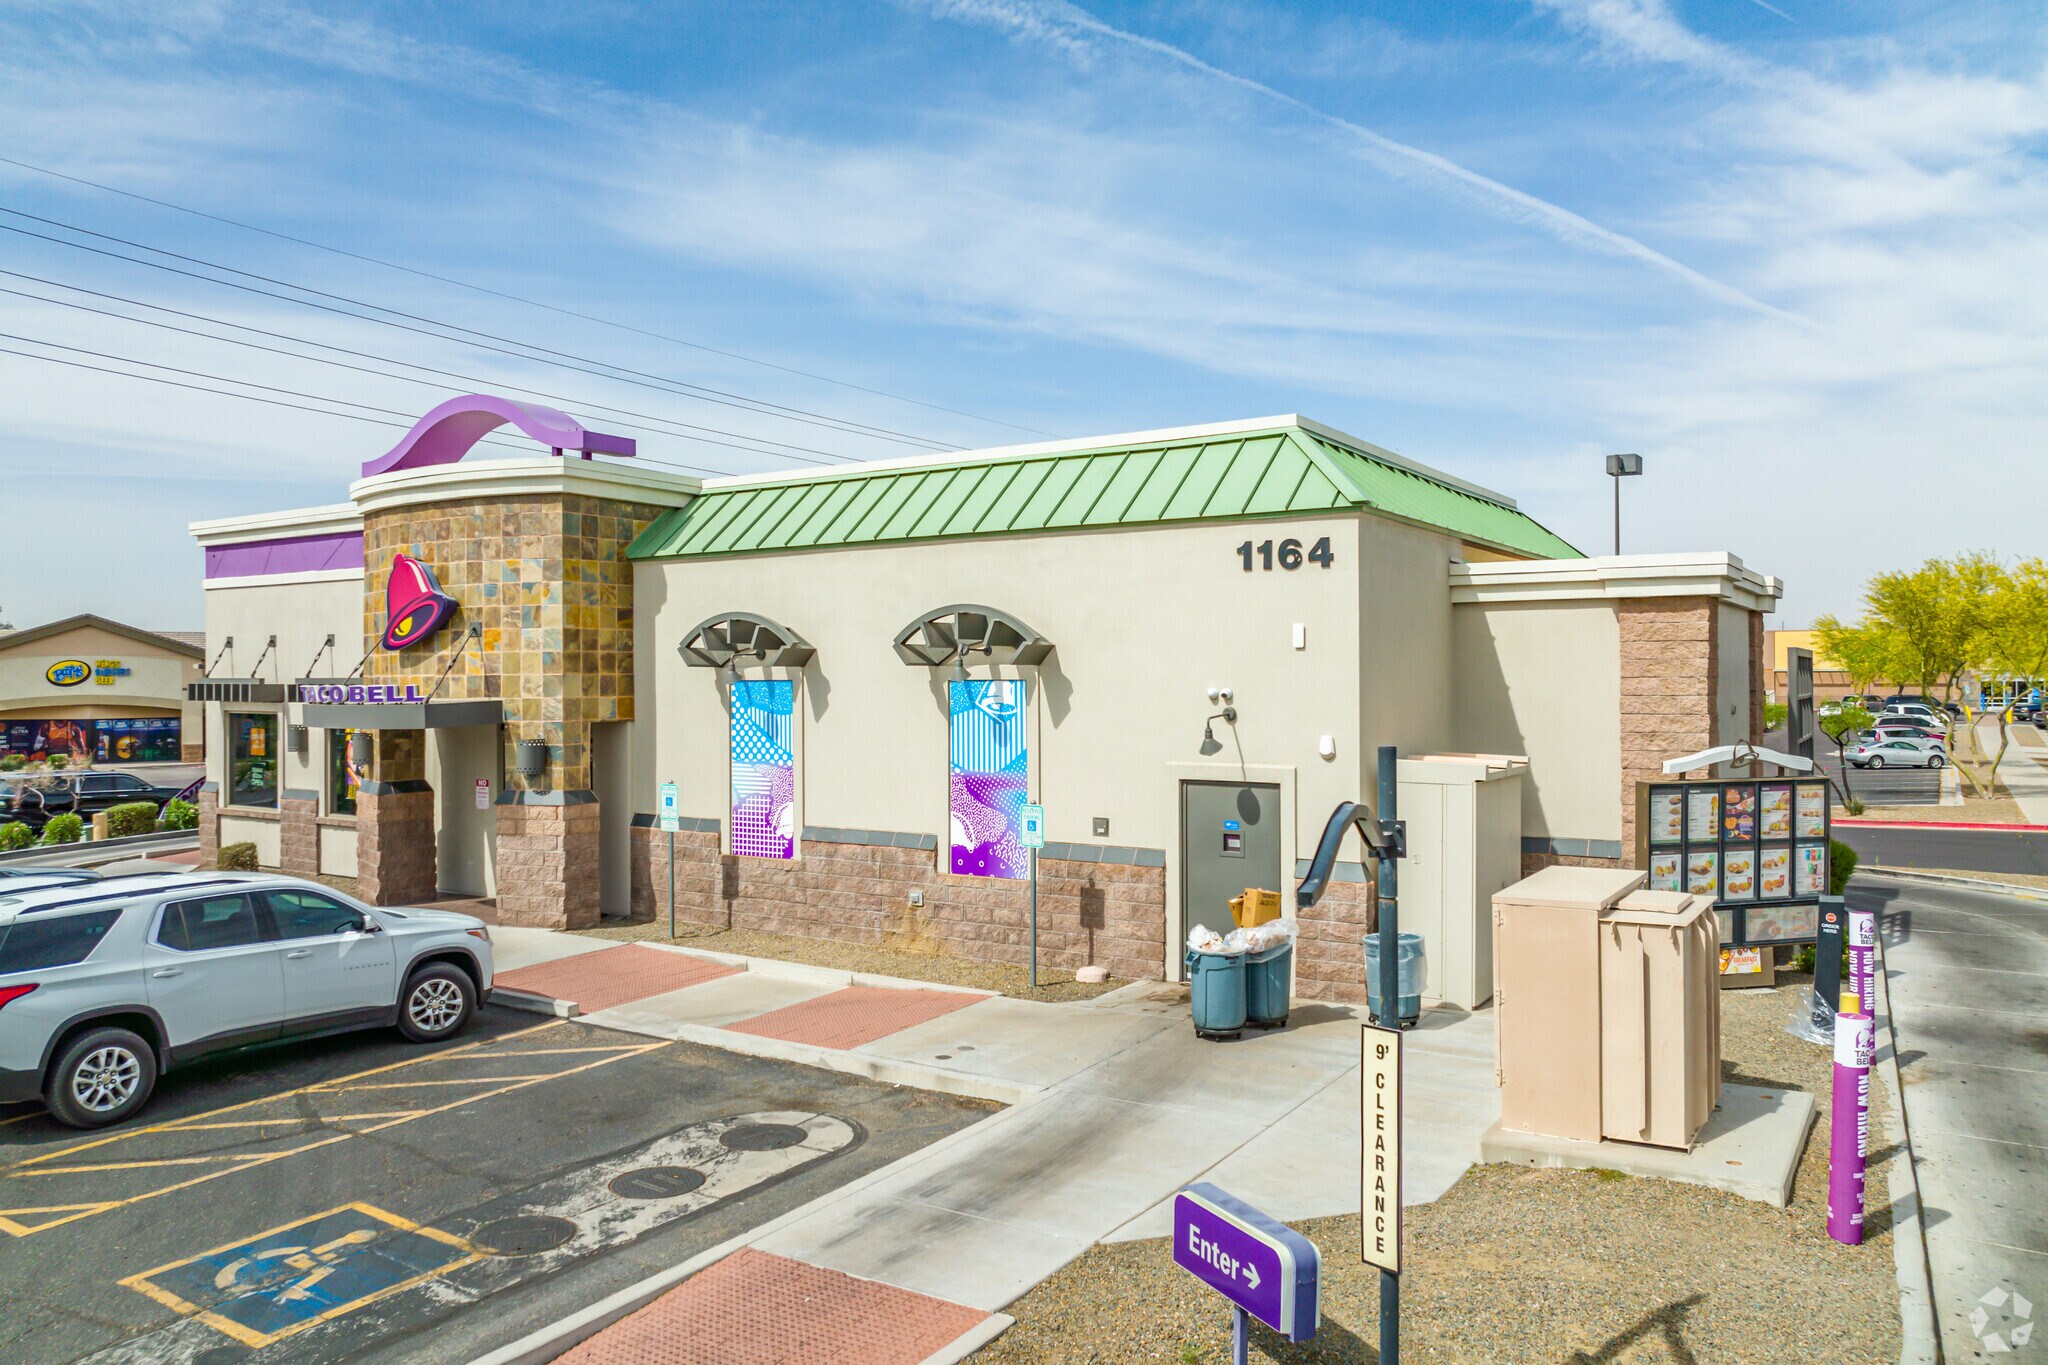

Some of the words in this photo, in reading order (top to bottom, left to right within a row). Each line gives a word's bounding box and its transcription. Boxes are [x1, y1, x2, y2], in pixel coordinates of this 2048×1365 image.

[1236, 537, 1334, 572] 1164
[95, 676, 114, 685] BEER
[299, 685, 345, 702] TACO
[349, 685, 425, 702] BELL
[1849, 950, 1858, 975] NOW
[1863, 951, 1873, 974] NOW
[1863, 977, 1874, 1010] HIRING
[1375, 1072, 1386, 1254] CLEARANCE
[1189, 1223, 1240, 1280] Enter
